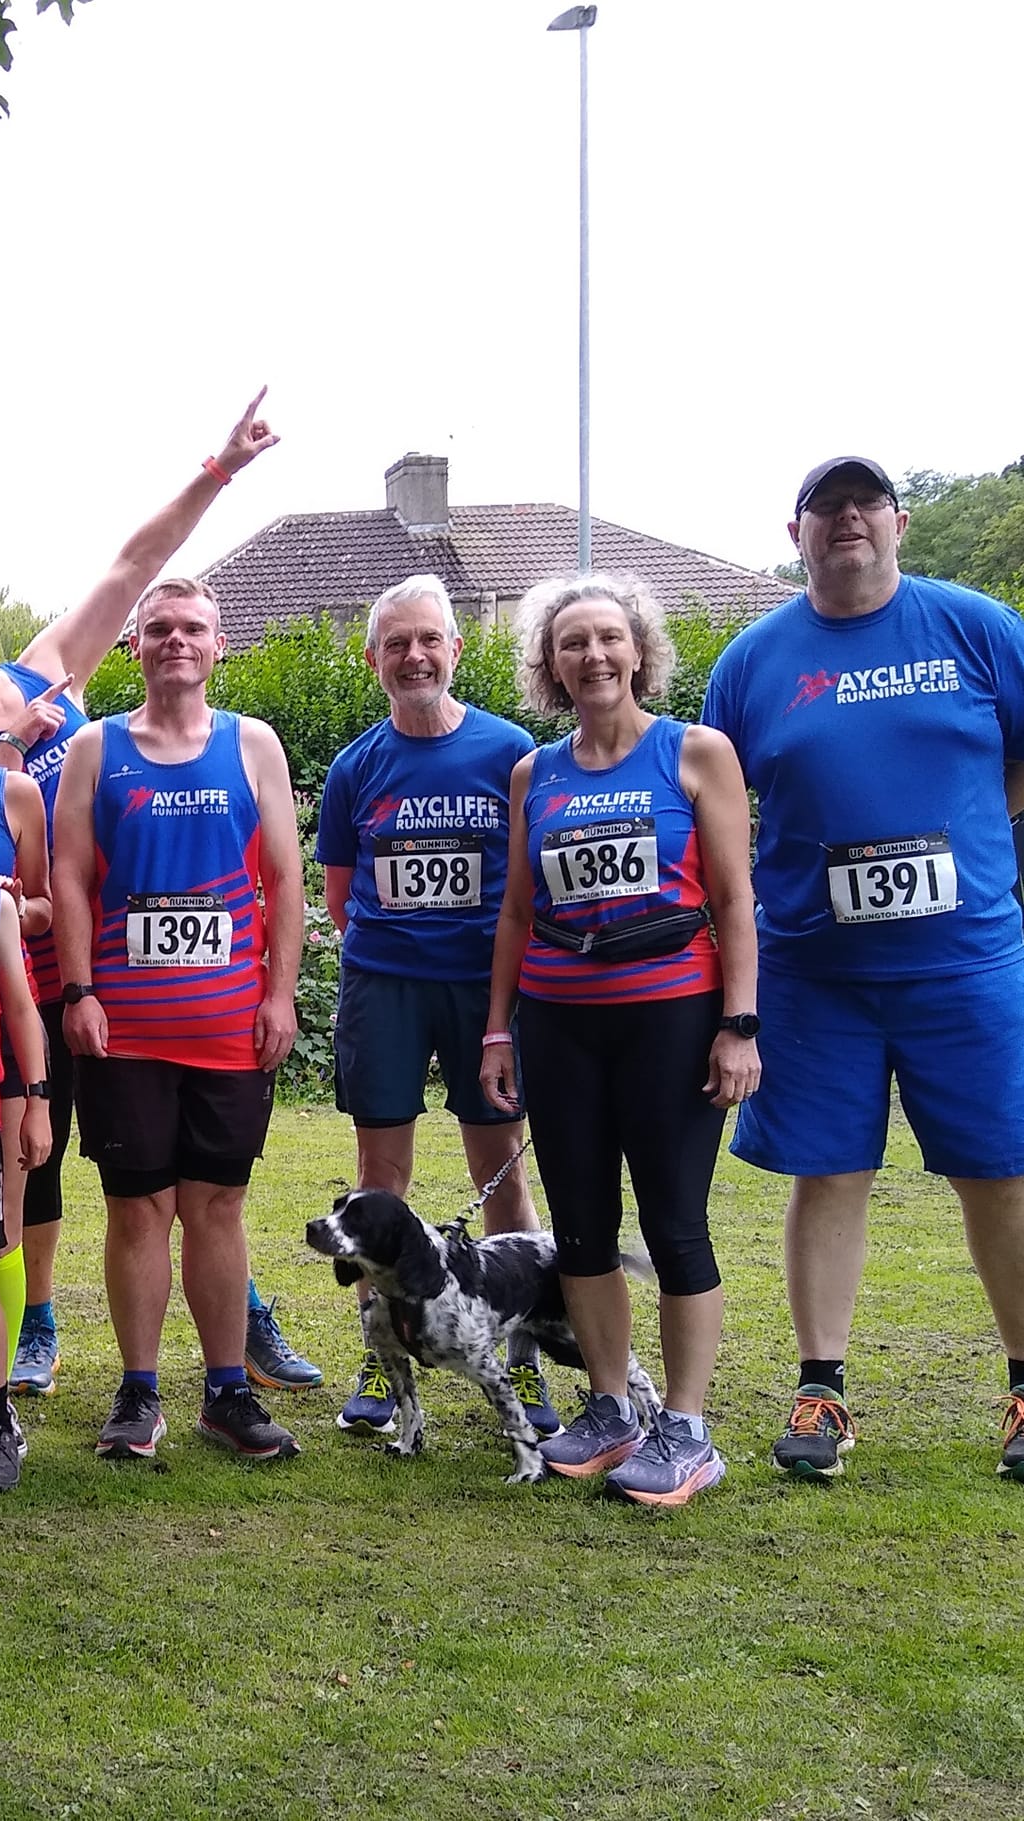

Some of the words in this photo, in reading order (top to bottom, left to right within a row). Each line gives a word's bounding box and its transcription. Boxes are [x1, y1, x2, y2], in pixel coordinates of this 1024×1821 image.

[837, 659, 958, 693] AYCLIFFE
[836, 683, 915, 704] RUNNING
[920, 679, 960, 693] CLUB
[151, 789, 229, 807] AYCLIFFE
[397, 796, 499, 818] AYCLIFFE
[567, 791, 652, 809] AYCLIFFE
[151, 806, 199, 816] RUNNING
[203, 806, 229, 814] CLUB
[564, 805, 615, 817] RUNNING
[620, 805, 650, 814] CLUB
[396, 817, 465, 830] RUNNING
[469, 817, 499, 829] CLUB
[389, 857, 470, 898] 1398
[558, 841, 645, 892] 1386
[847, 859, 939, 911] 1391
[844, 911, 898, 922] DARLINGTON
[901, 908, 923, 916] TRAIL
[925, 904, 947, 913] SERIES
[143, 915, 222, 955] 1394
